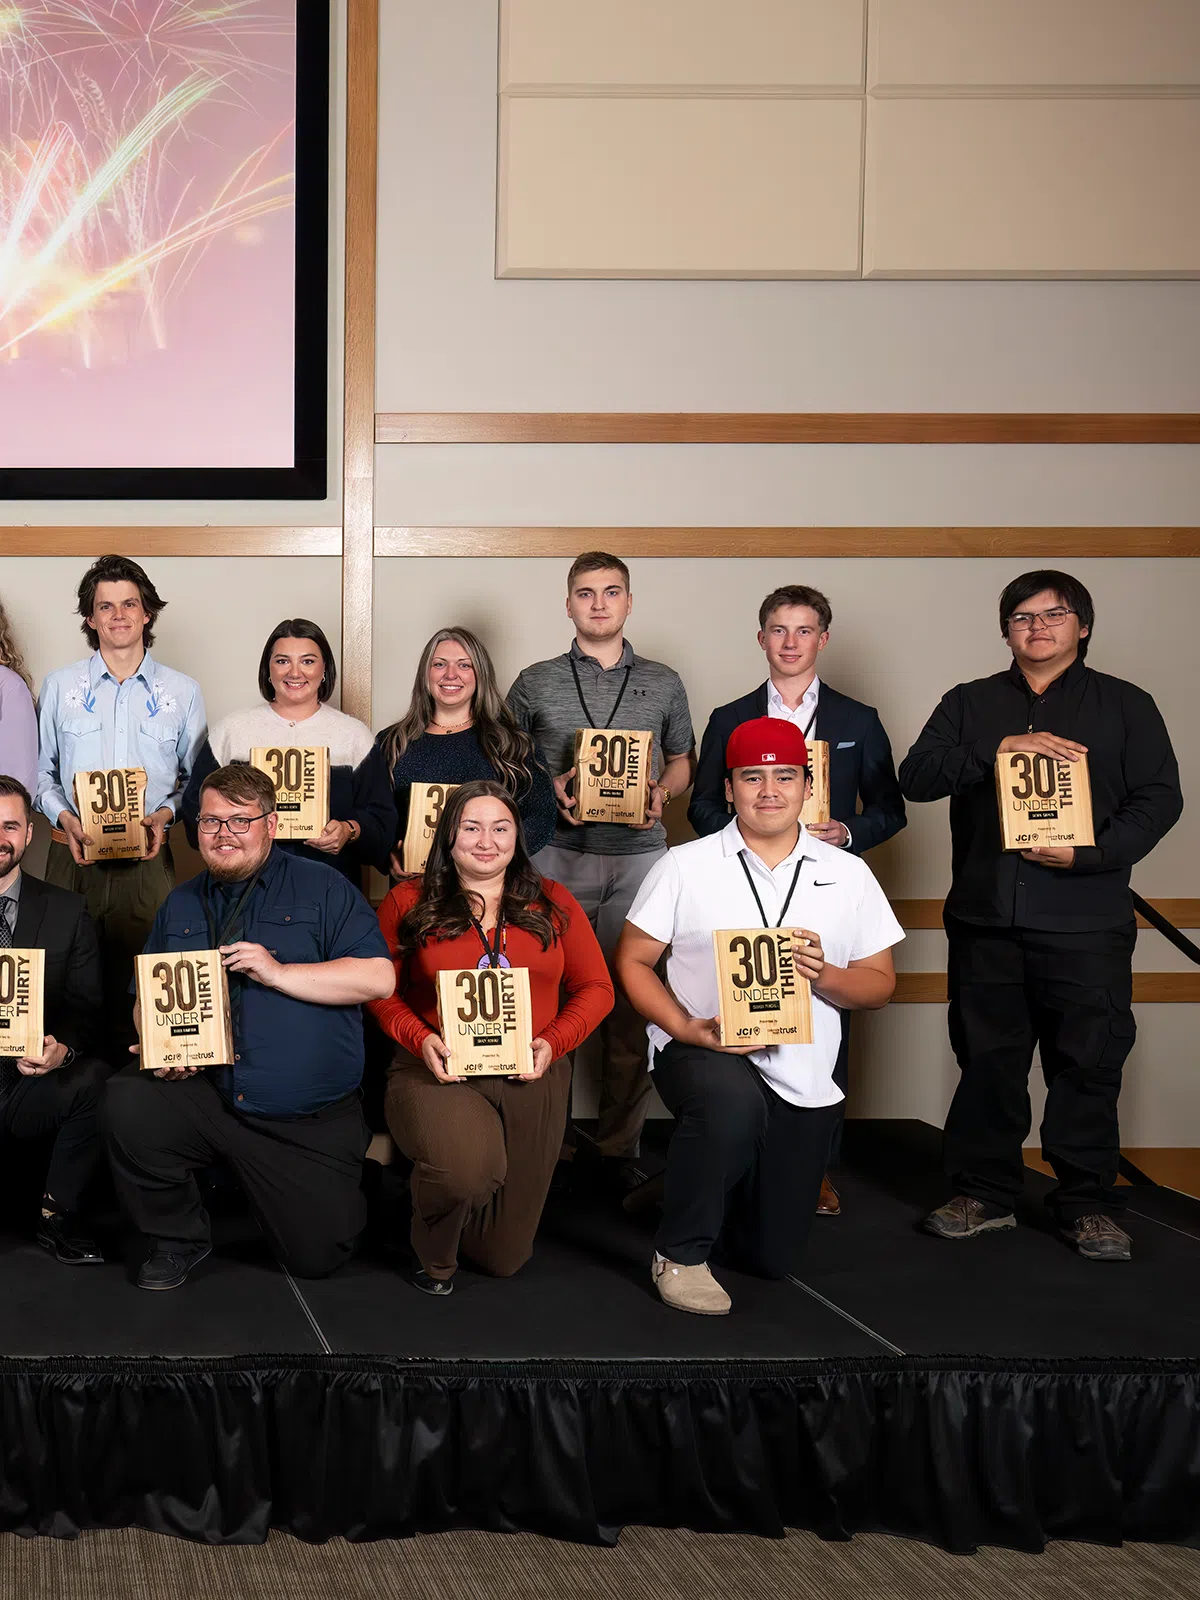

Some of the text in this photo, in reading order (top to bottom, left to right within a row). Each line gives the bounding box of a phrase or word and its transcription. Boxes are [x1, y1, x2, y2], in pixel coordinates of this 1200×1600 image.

[266, 748, 302, 791] 30
[304, 749, 315, 802] THIRTY
[589, 734, 627, 777] 30
[627, 737, 640, 788] THIRTY
[1010, 753, 1056, 799] 30
[89, 770, 125, 813] 30
[125, 769, 139, 821] THIRTY
[588, 778, 624, 788] UNDER
[1013, 800, 1057, 811] UNDER
[1057, 760, 1073, 808] THIRT
[92, 813, 127, 824] UNDER
[730, 934, 777, 988] 30
[777, 934, 795, 998] THIRTY
[17, 956, 29, 1016] THIRTY
[153, 960, 197, 1013] 30
[196, 960, 213, 1022] THIRTY
[456, 970, 500, 1022] 30
[500, 970, 516, 1033] THIRTY
[733, 988, 779, 1002] UNDER
[156, 1012, 198, 1026] UNDER
[458, 1023, 501, 1035] UNDER
